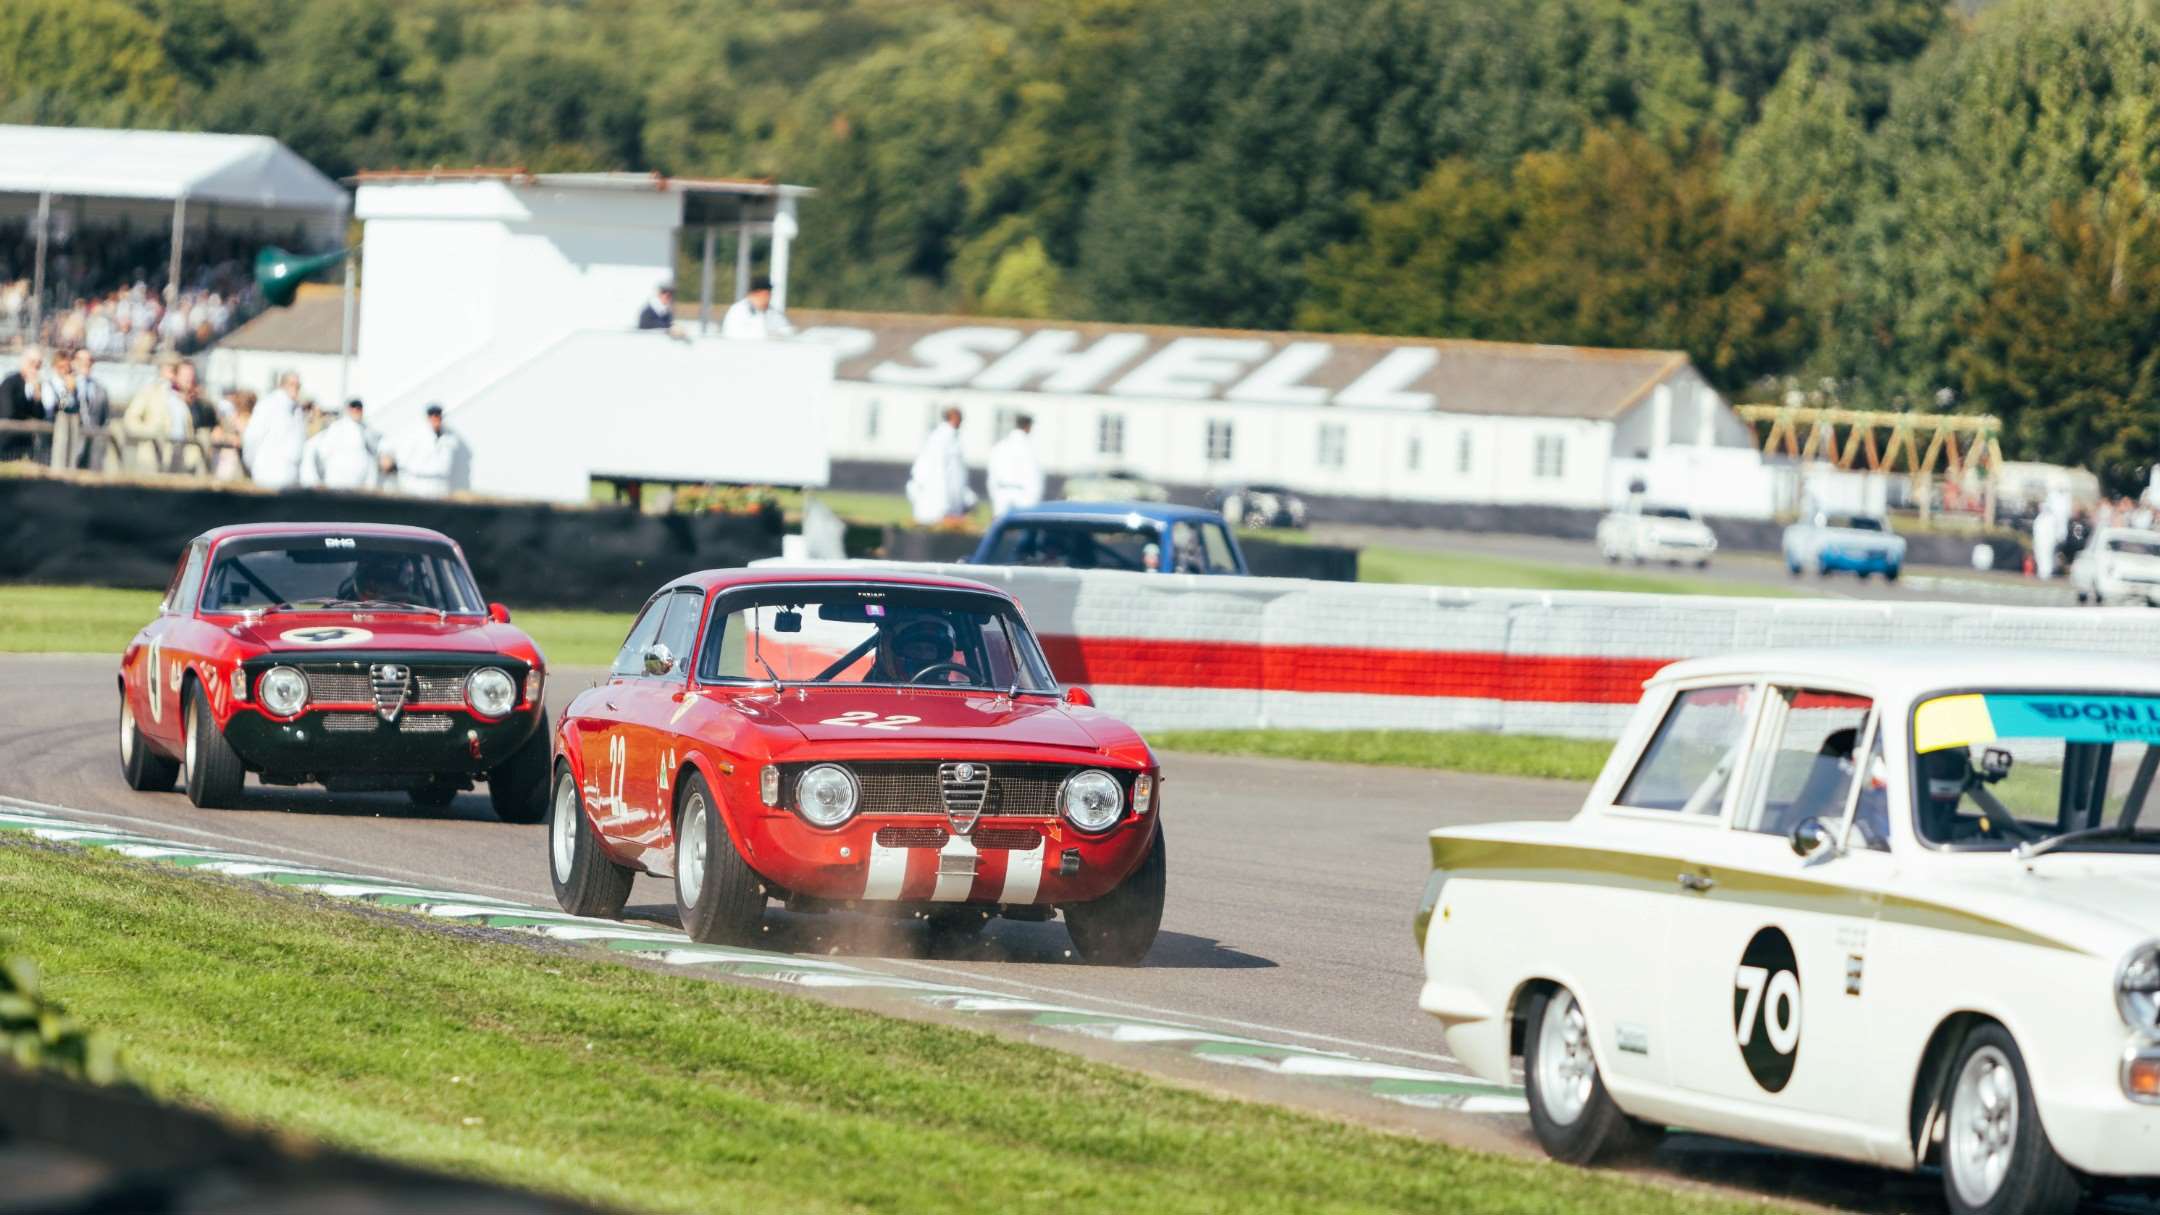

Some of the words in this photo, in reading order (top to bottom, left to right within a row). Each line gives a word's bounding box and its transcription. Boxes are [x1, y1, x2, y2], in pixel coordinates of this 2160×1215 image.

[868, 325, 1440, 412] SHELL
[293, 628, 352, 642] 4
[818, 710, 922, 732] 22
[2056, 702, 2137, 721] DON
[609, 734, 627, 818] 22
[1735, 964, 1801, 1055] 70
